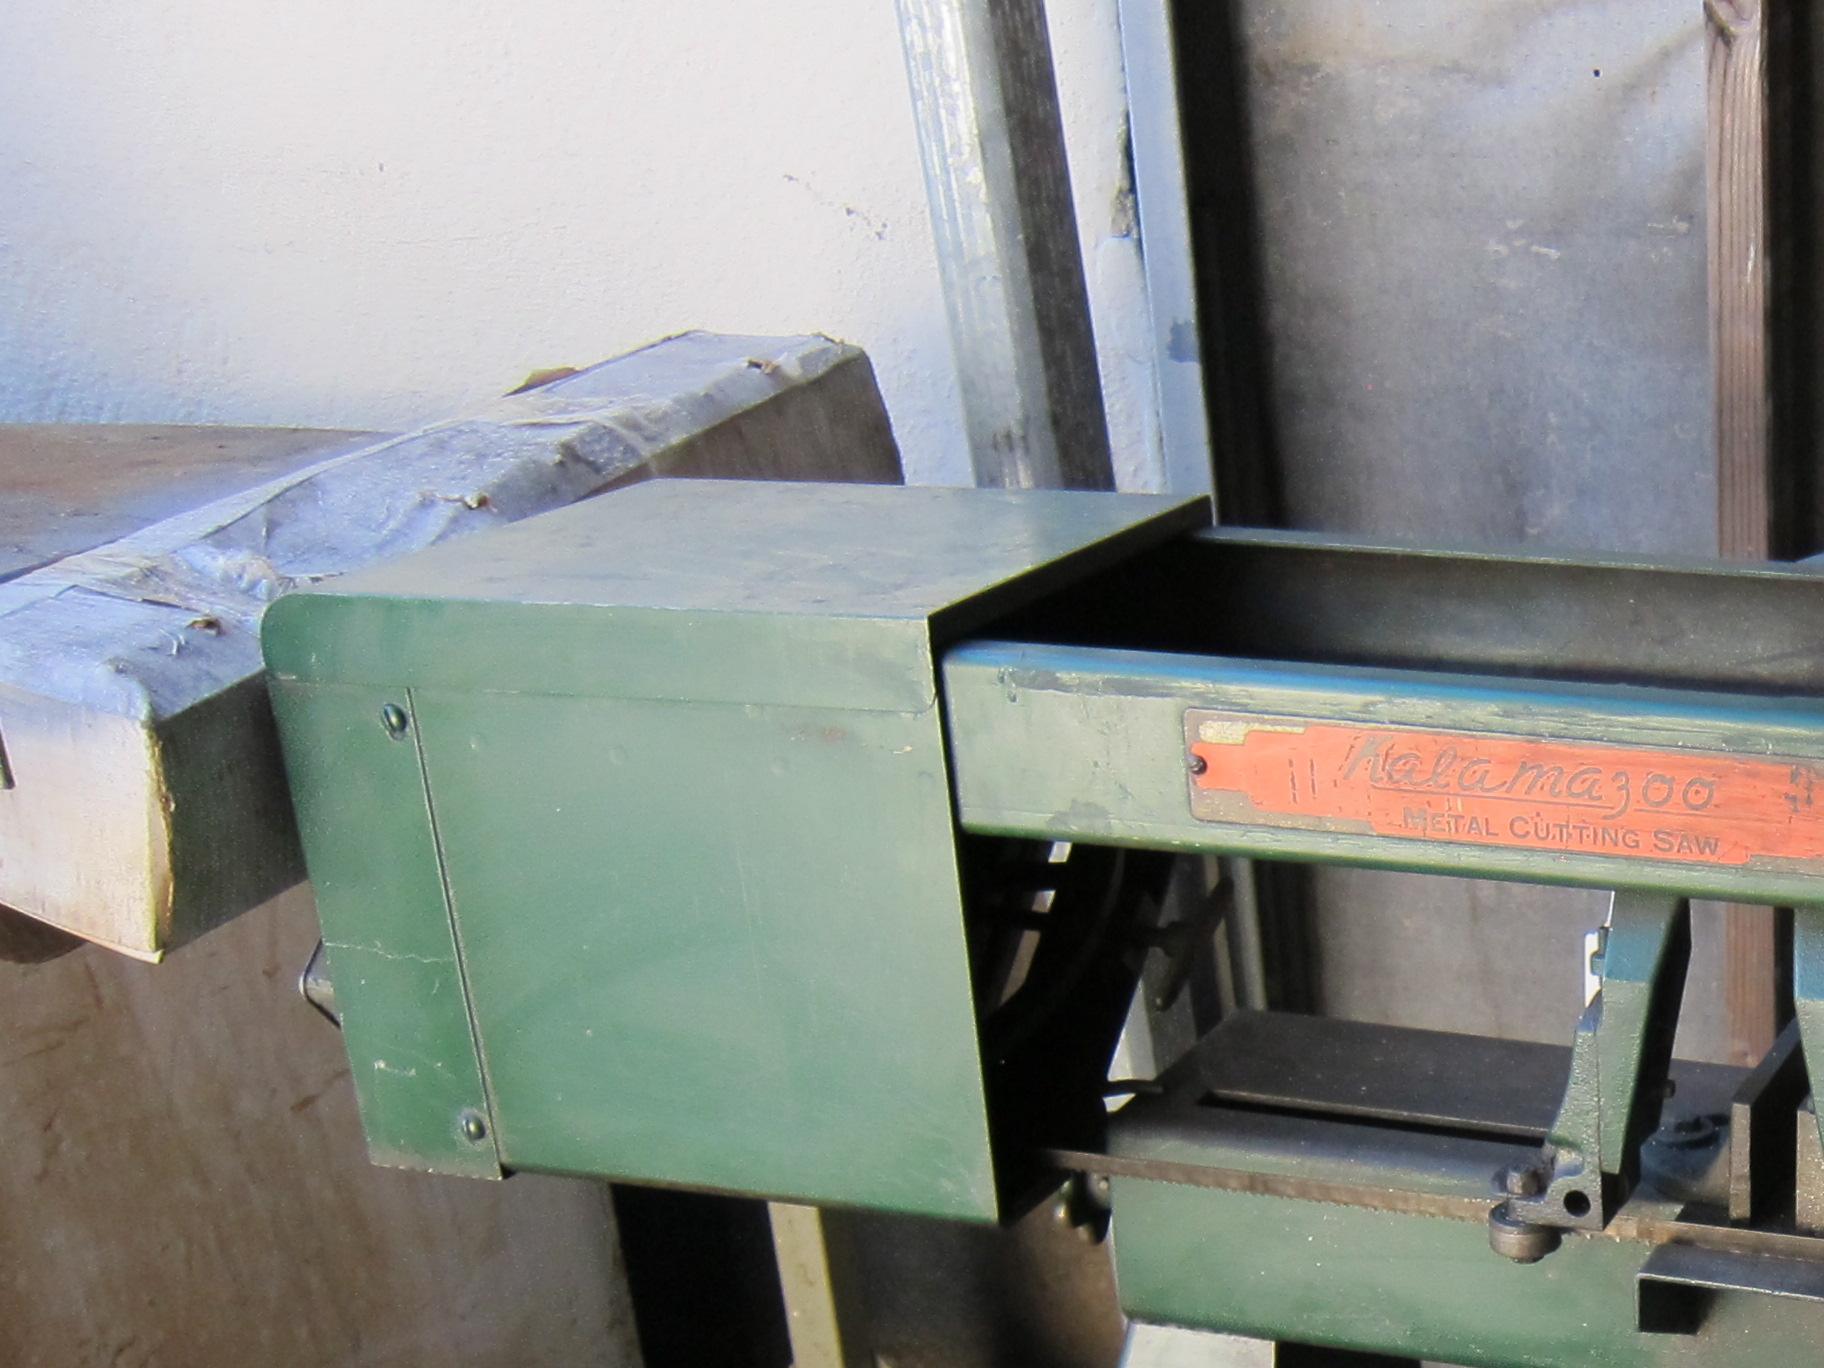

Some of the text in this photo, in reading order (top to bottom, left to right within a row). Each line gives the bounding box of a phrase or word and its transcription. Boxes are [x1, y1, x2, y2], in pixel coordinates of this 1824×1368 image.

[1343, 733, 1718, 820] Kalamazoo
[1403, 806, 1721, 857] METAL CUTTING SAW
